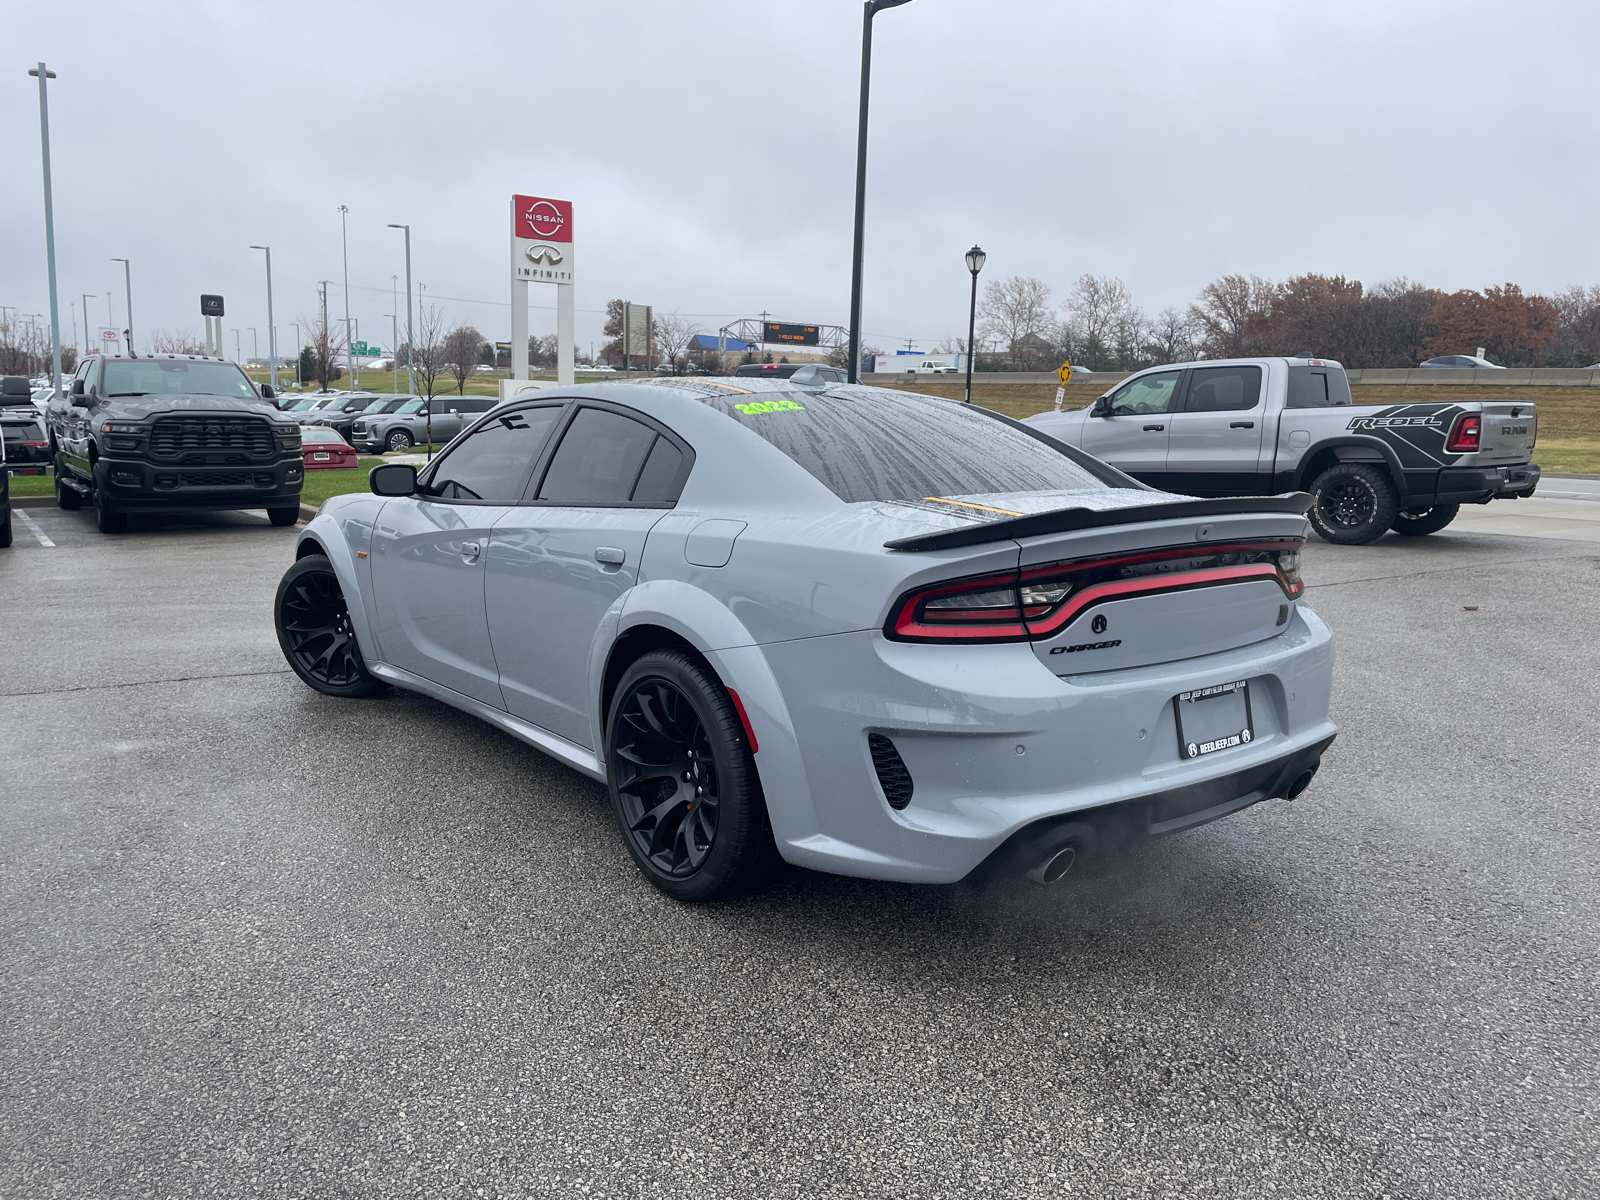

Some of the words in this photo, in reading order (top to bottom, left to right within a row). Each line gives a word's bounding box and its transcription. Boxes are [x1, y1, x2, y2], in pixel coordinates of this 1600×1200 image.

[526, 213, 564, 224] NISSAN
[518, 268, 571, 280] INFINITI
[734, 400, 806, 415] 2022
[183, 425, 243, 433] RAM
[1346, 416, 1442, 430] REBEL
[1502, 425, 1527, 435] RAM
[1049, 639, 1122, 655] CHARGER
[1191, 690, 1201, 699] JEEP
[1202, 685, 1223, 696] CHRYSLER
[1223, 683, 1236, 692] DODGE
[1236, 680, 1246, 688] RAM
[1200, 735, 1240, 755] REEDJEEP.COM
